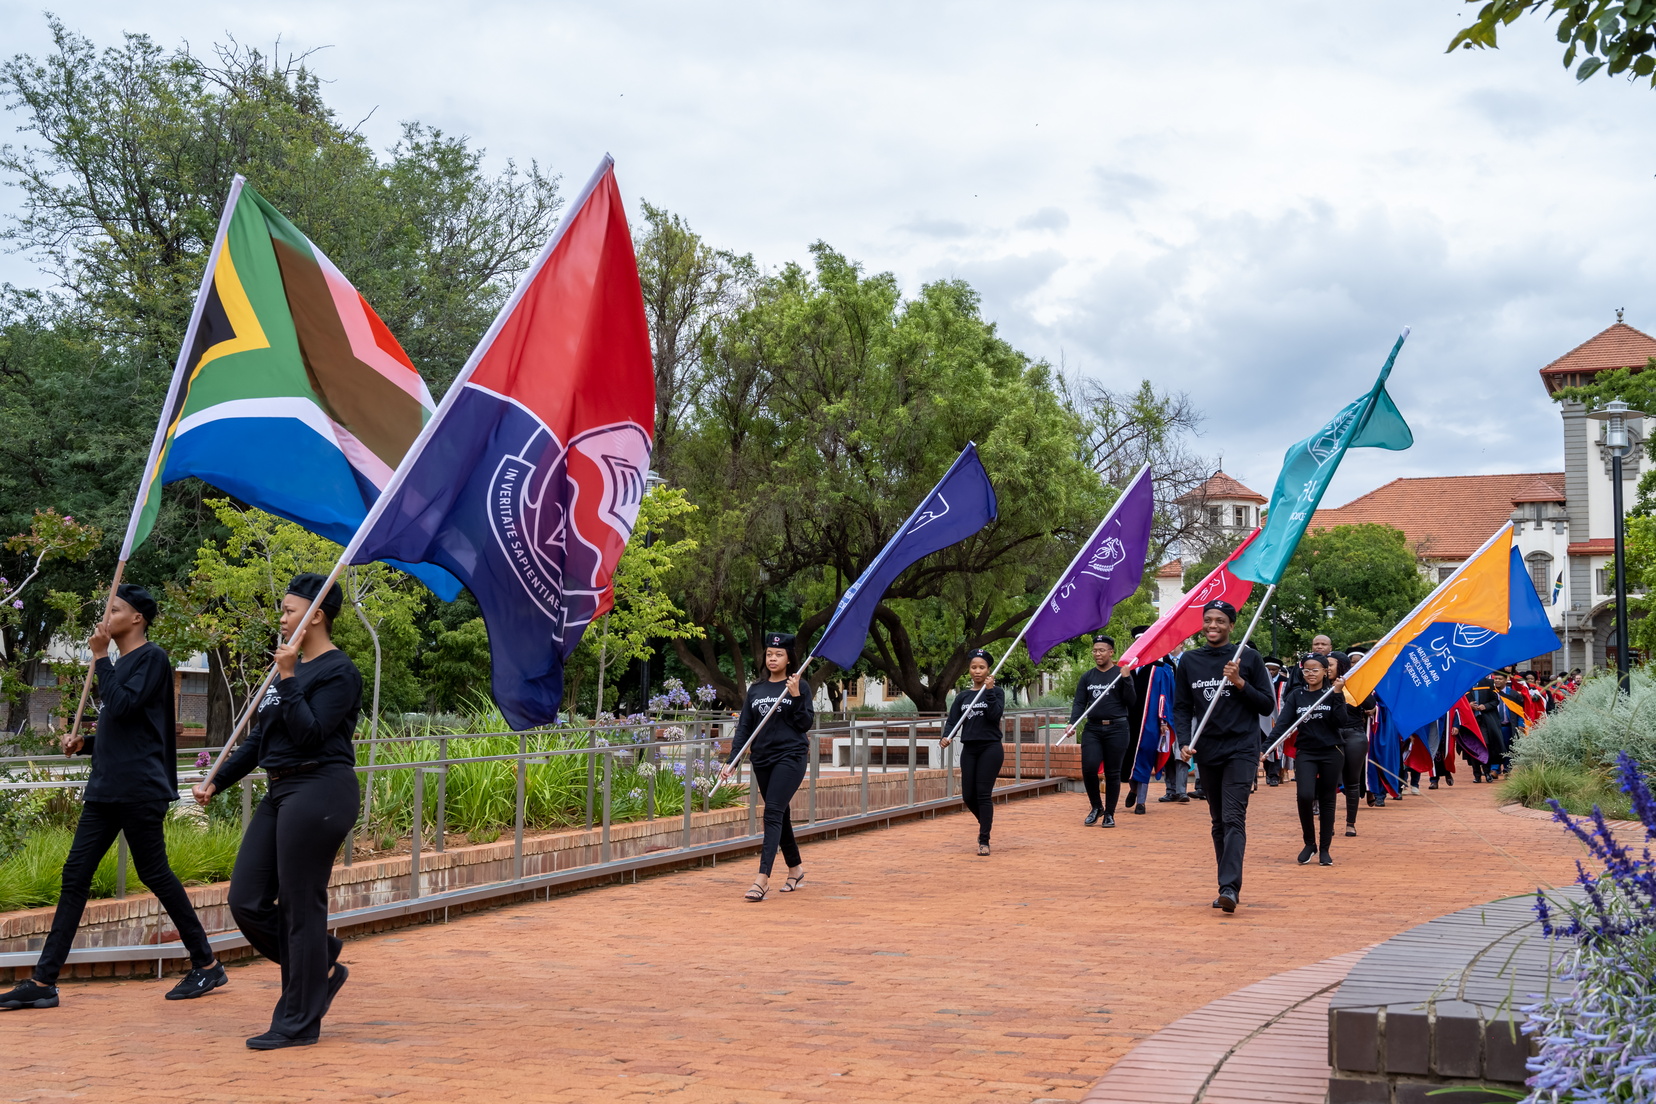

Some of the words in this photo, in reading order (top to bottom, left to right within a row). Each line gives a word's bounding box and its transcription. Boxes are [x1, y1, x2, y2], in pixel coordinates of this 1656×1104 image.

[504, 467, 519, 481] IN
[499, 482, 518, 539] VERITATE
[511, 540, 560, 611] SAPIENTIAE
[1408, 651, 1432, 687] AGRICULTURAL
[1416, 647, 1433, 671] NATURAL
[1429, 669, 1440, 682] AND
[1430, 636, 1456, 672] UFS
[1404, 662, 1422, 687] SCIENCES
